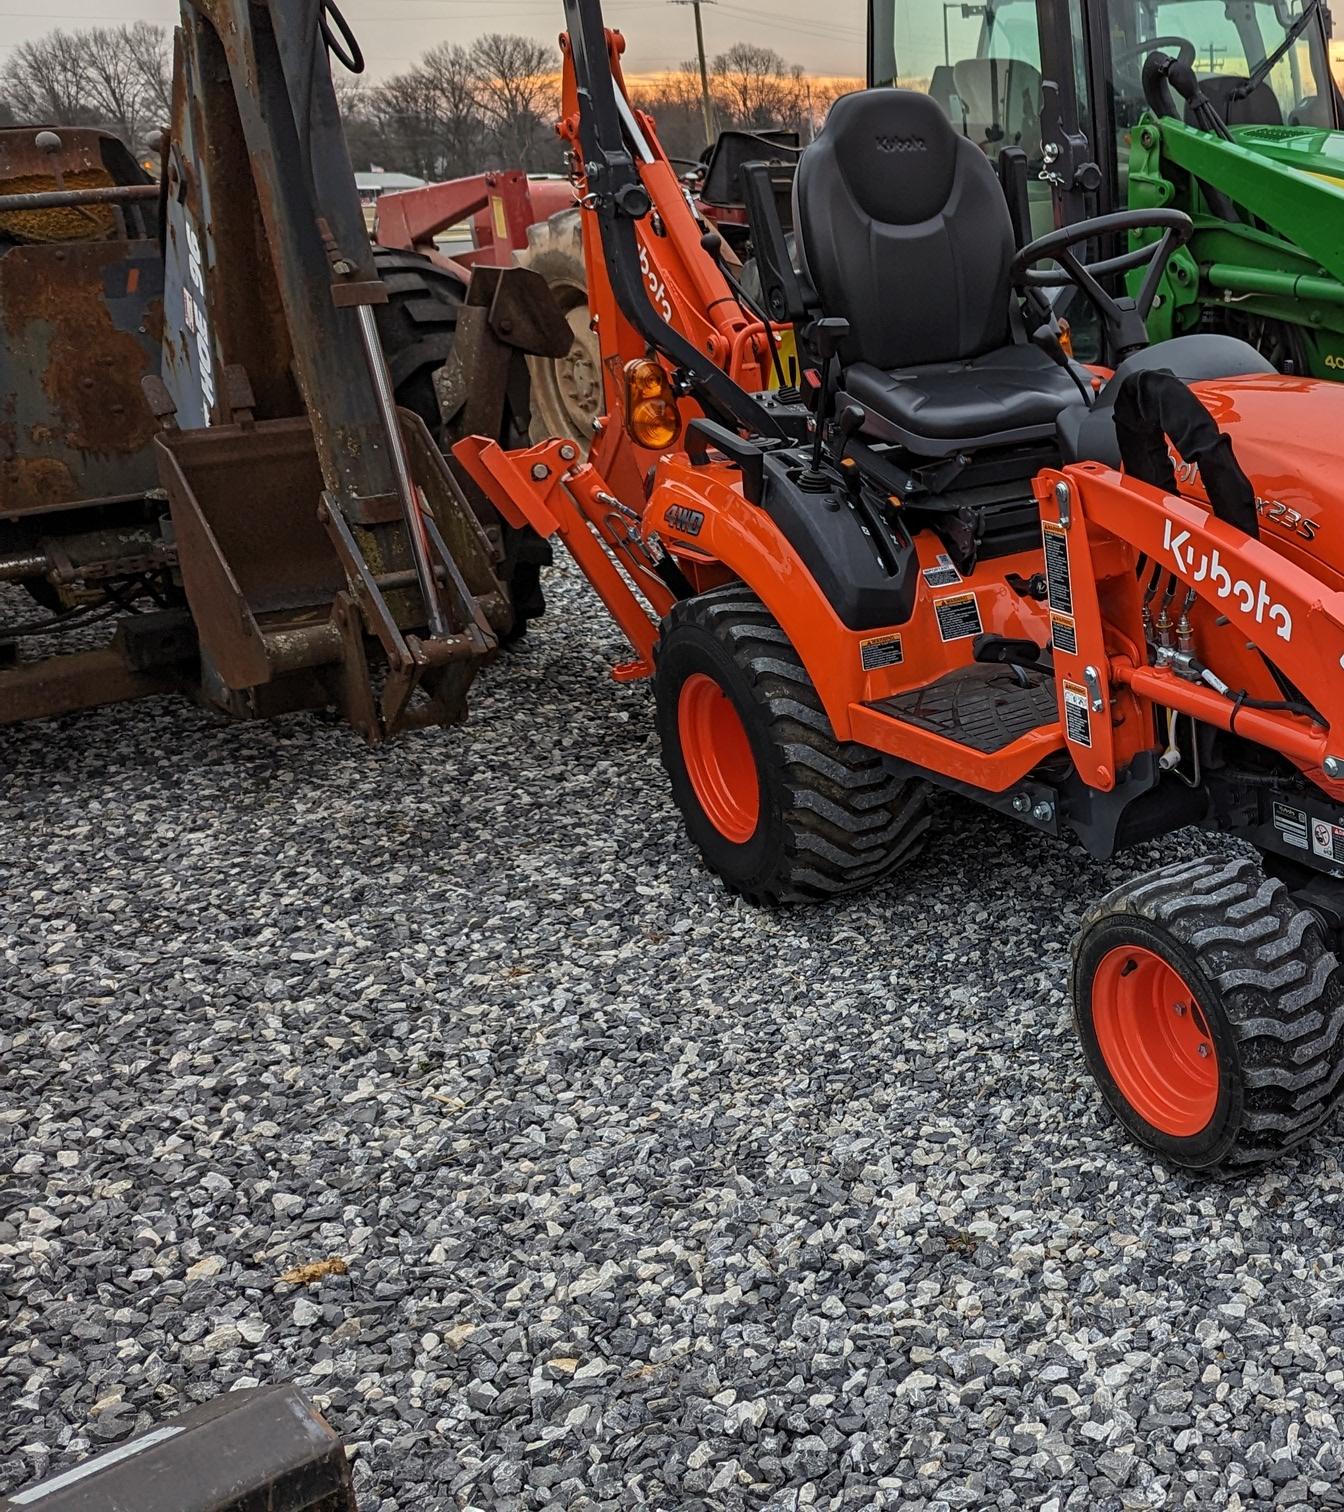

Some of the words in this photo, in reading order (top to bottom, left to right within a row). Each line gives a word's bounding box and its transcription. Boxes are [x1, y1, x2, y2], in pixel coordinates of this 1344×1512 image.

[185, 220, 205, 297] 96
[637, 242, 672, 323] bota
[664, 503, 705, 537] 4WD
[1255, 496, 1321, 541] X23S
[1163, 518, 1293, 642] Kubota
